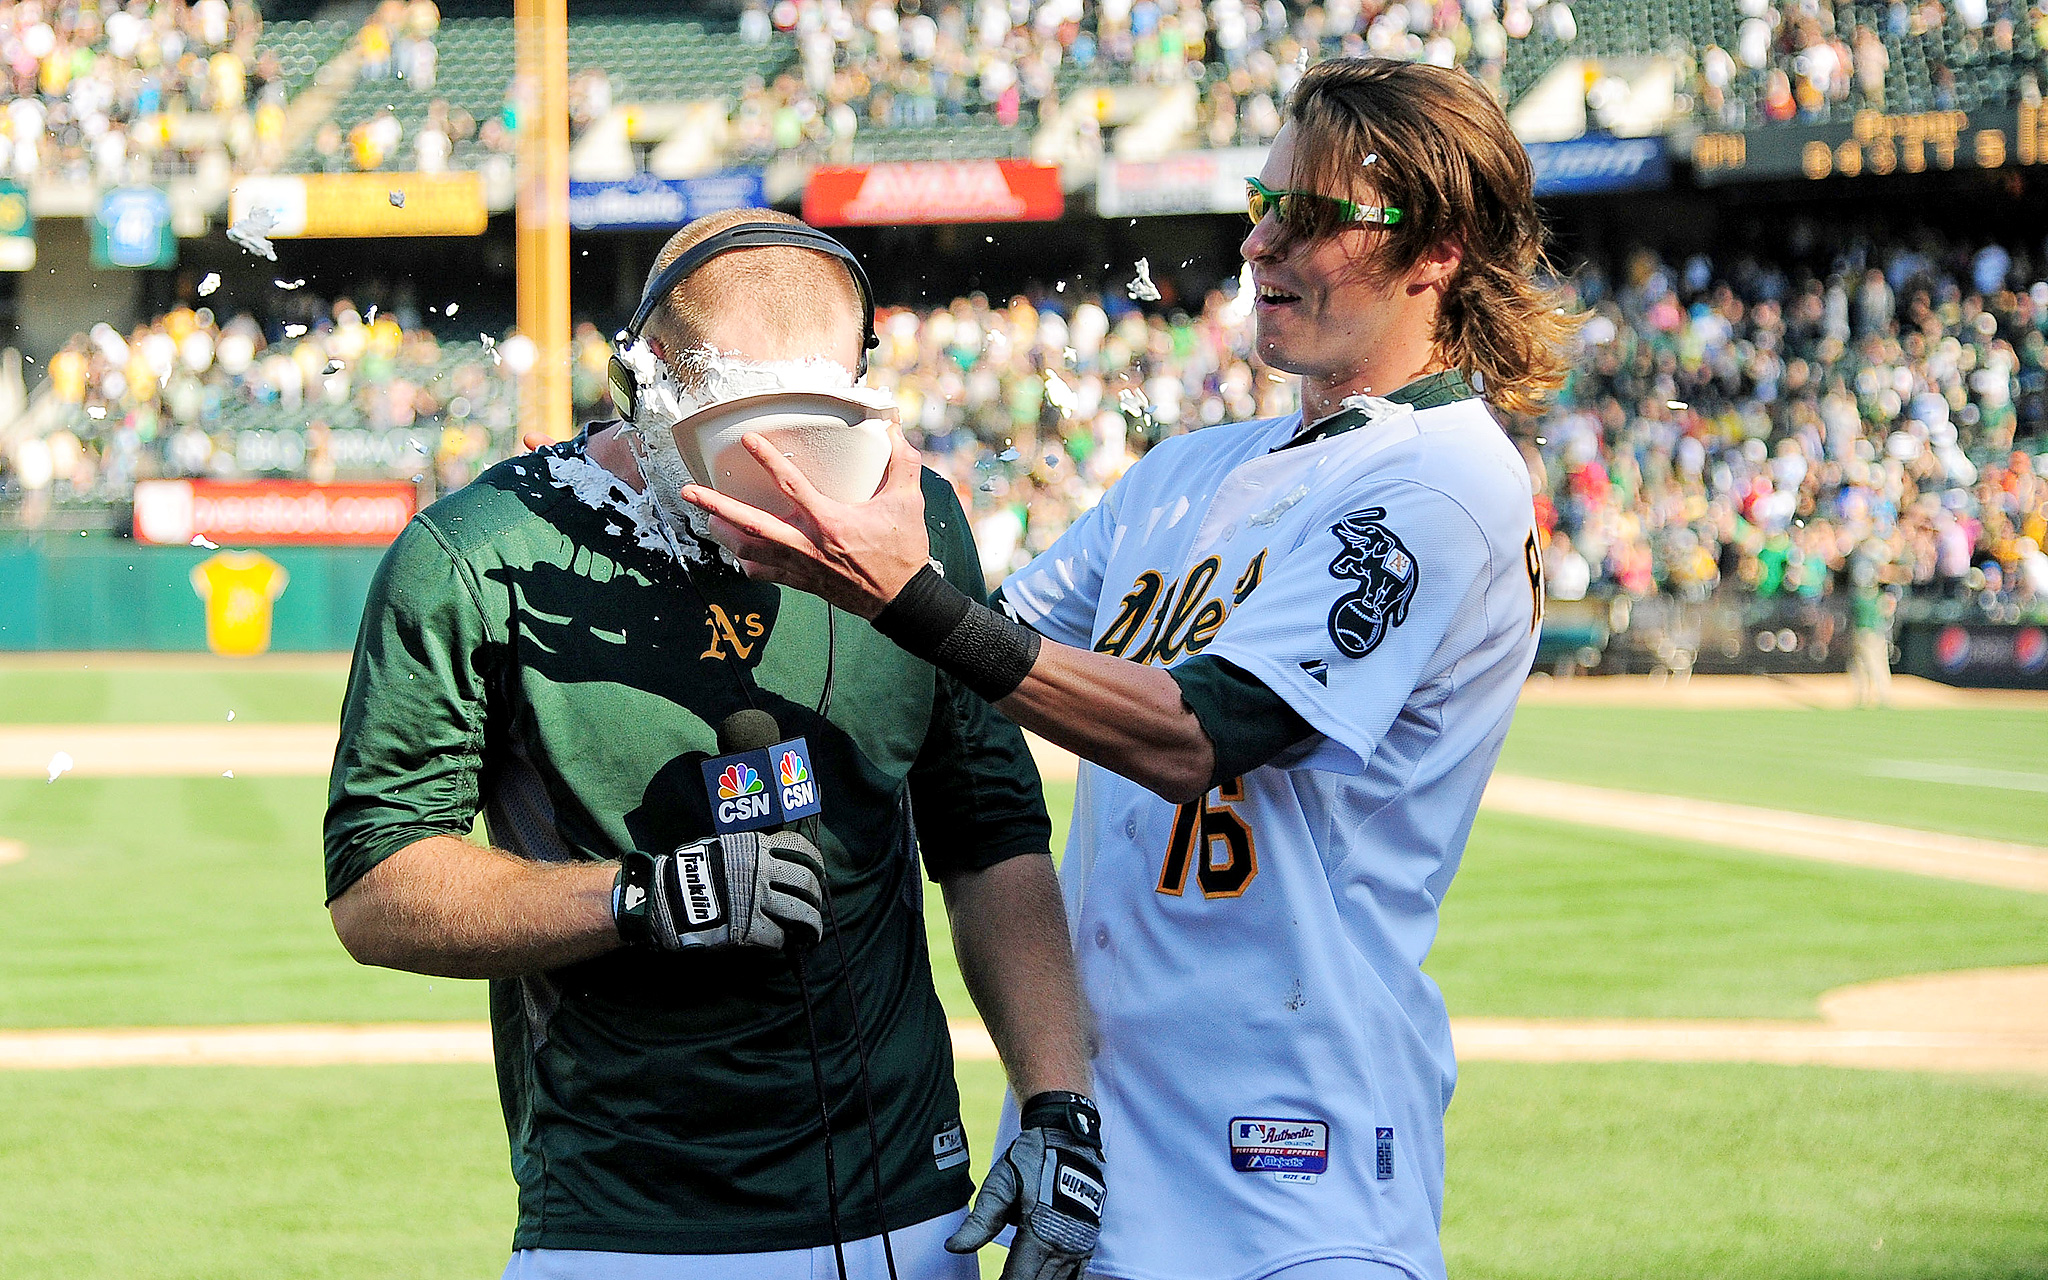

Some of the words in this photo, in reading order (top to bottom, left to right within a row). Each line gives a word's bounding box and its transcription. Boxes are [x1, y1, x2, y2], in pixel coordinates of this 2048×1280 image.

[700, 603, 765, 661] A's
[718, 793, 770, 824] CSN
[782, 780, 814, 811] CSN
[1156, 776, 1258, 899] 16
[1262, 1126, 1315, 1144] Authentic
[1264, 1155, 1304, 1168] Majestic
[1286, 1149, 1320, 1157] APPAREL
